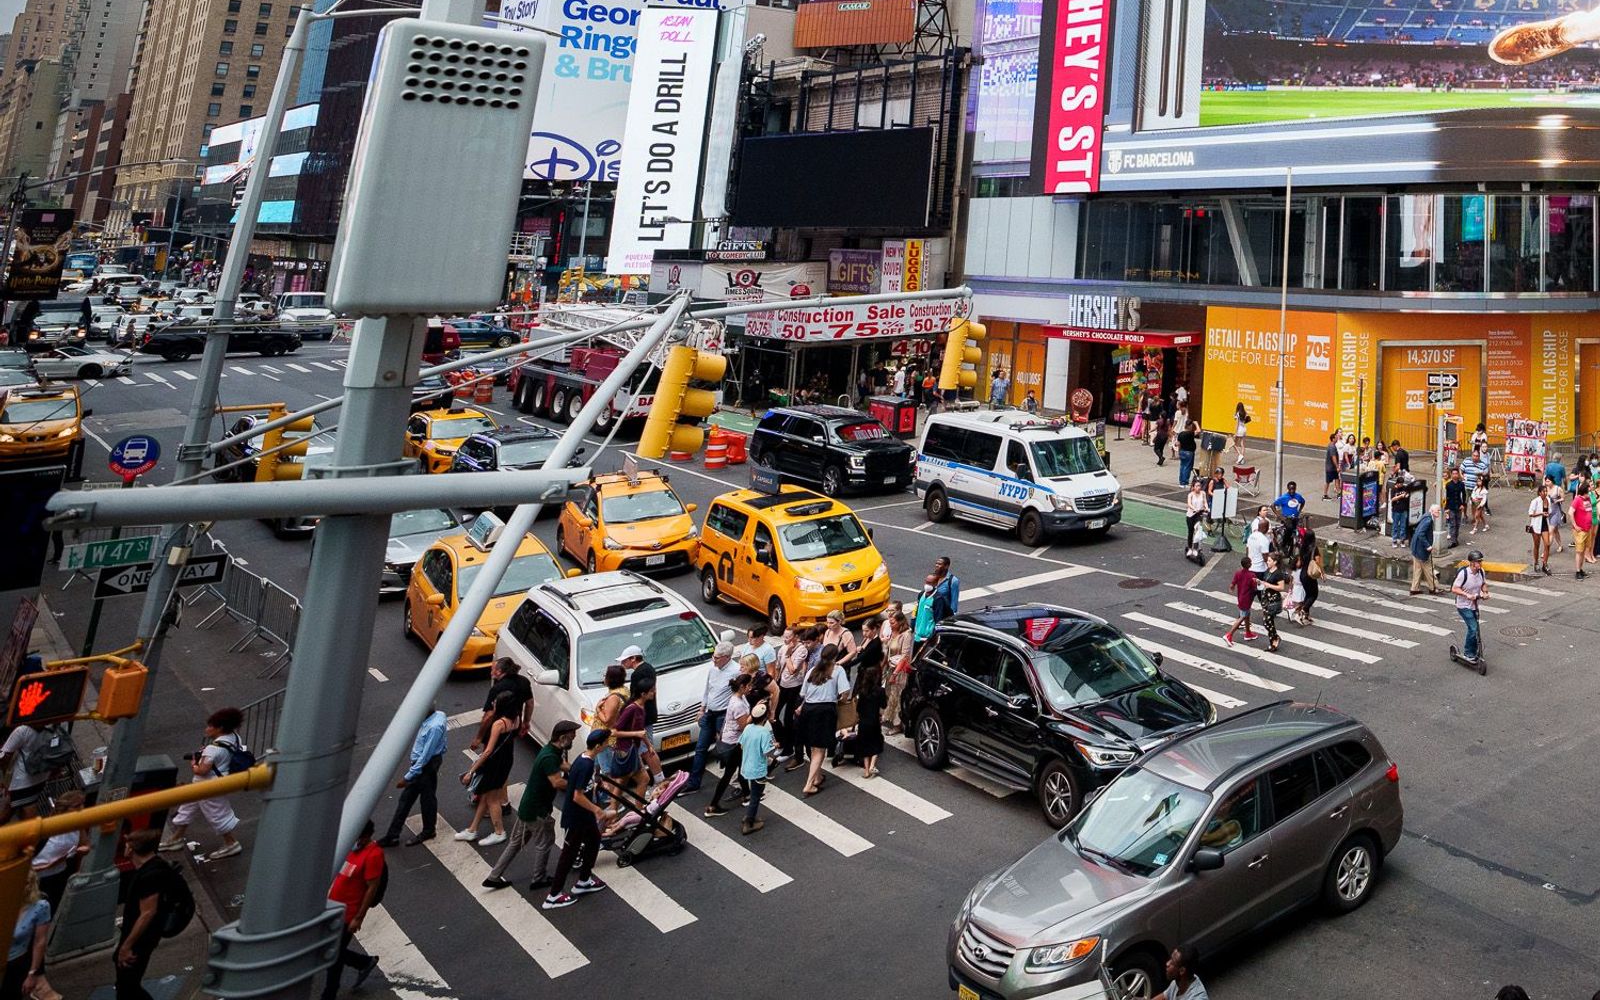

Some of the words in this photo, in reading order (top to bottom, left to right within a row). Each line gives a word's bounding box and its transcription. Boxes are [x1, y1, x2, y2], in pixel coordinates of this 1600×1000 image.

[516, 0, 539, 20] Story
[840, 2, 869, 10] LAMAR
[659, 15, 694, 28] ASIAN
[660, 30, 696, 43] DOLL
[554, 54, 580, 79] &
[654, 52, 688, 114] DRILL
[651, 119, 680, 137] A
[646, 142, 675, 176] DO
[1123, 153, 1135, 168] FC
[1136, 150, 1195, 168] BARCELONA
[637, 178, 672, 243] LET'S
[718, 241, 757, 251] GIFTS
[838, 263, 875, 284] GIFTS
[777, 307, 854, 324] Construction
[867, 303, 905, 321] Sale
[910, 303, 951, 318] Construction
[1069, 295, 1141, 332] HERSHEY'S
[881, 327, 904, 336] OFF
[1062, 329, 1090, 338] HERSHEY'S
[1091, 332, 1123, 341] CHOCOLATE
[1124, 335, 1145, 343] WORLD
[1208, 328, 1242, 349] RETAIL
[1207, 350, 1238, 364] SPACE
[1240, 352, 1261, 366] FOR
[1359, 332, 1370, 374] LEASE
[1407, 349, 1440, 365] 14,370
[1442, 349, 1455, 363] SF
[1559, 331, 1569, 369] LEASE
[1341, 331, 1357, 392] FLAGSHIP
[1543, 329, 1557, 392] FLAGSHIP
[1559, 371, 1568, 393] FOR
[1559, 397, 1568, 435] SPACE
[120, 462, 153, 475] STANDING
[998, 482, 1028, 501] NYPD
[92, 545, 108, 564] W
[110, 542, 134, 560] 47
[138, 540, 149, 552] St
[118, 571, 151, 587] ONE
